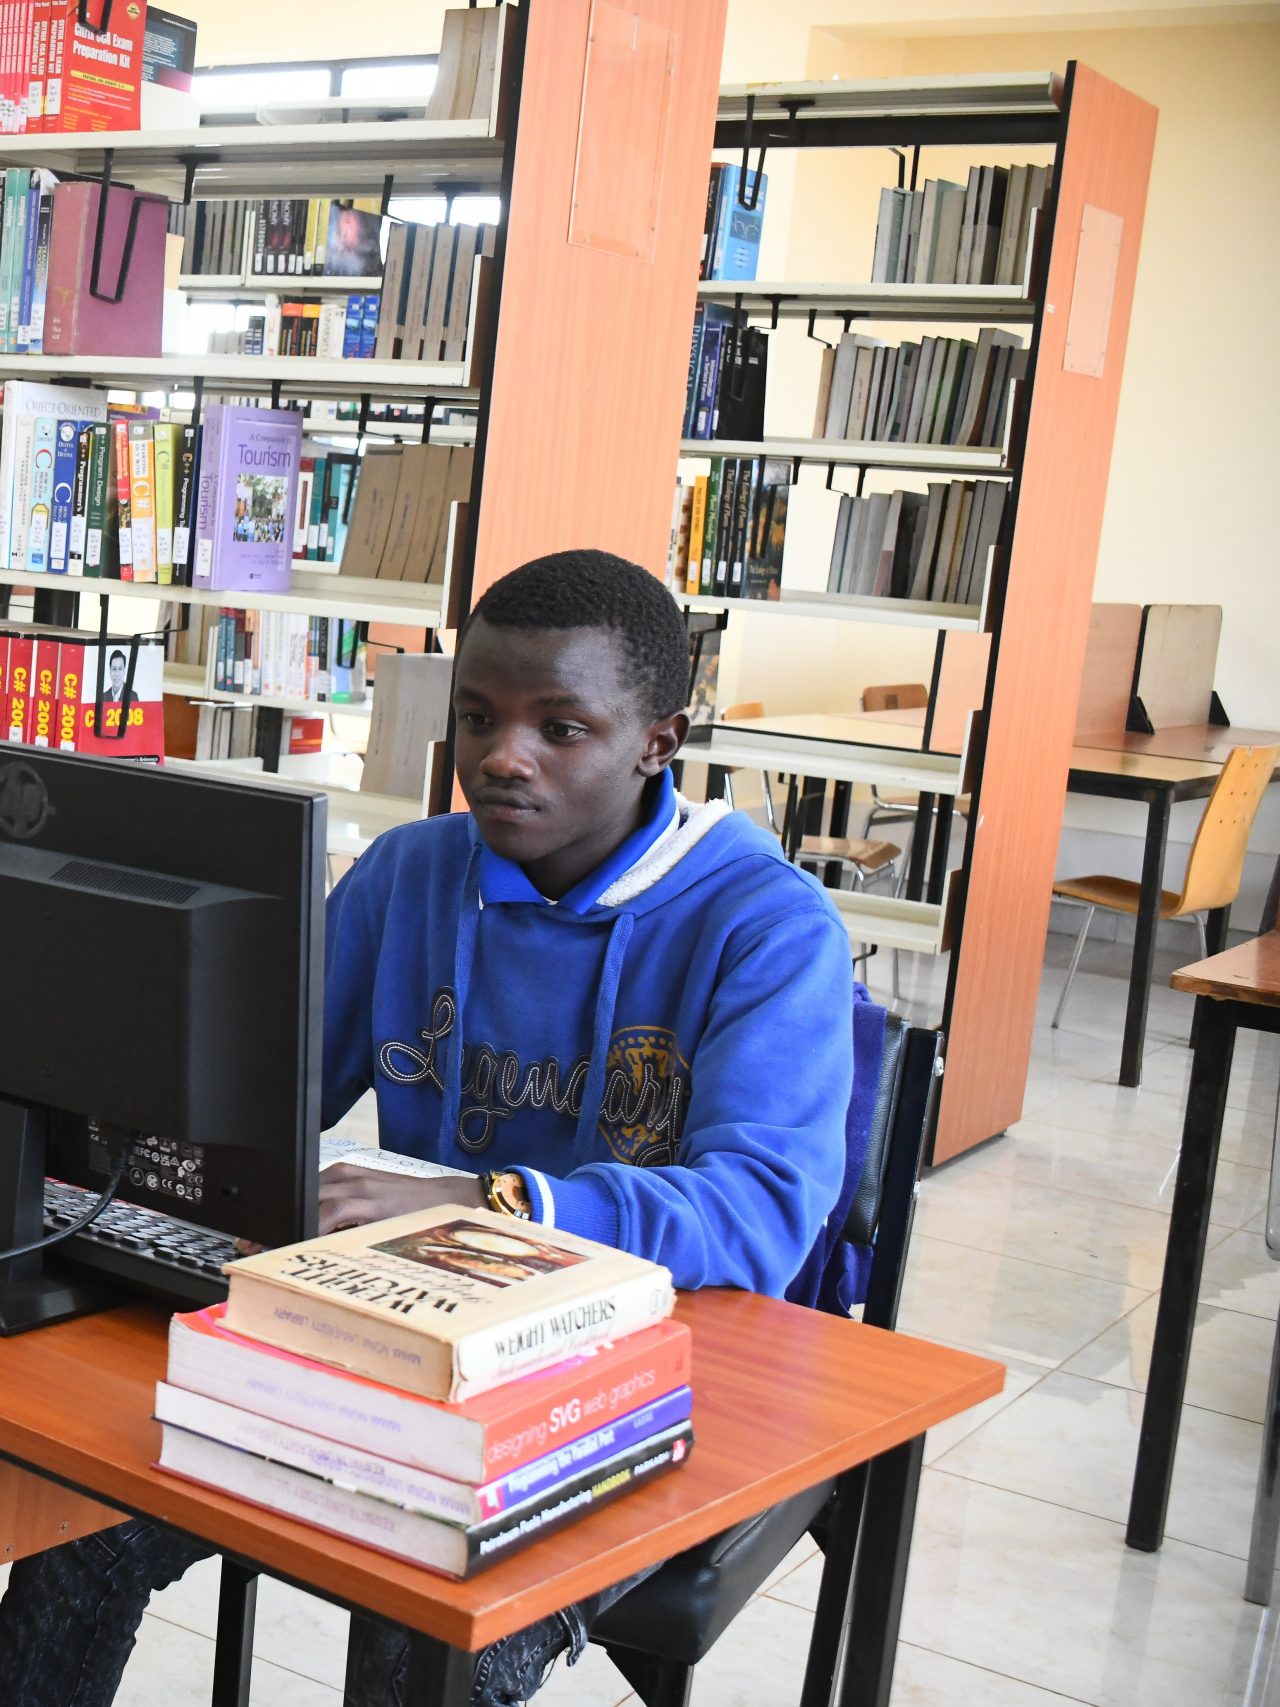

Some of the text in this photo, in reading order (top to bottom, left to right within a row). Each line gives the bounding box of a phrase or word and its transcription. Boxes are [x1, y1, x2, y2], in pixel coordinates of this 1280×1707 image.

[73, 40, 118, 66] Preparation
[258, 219, 266, 254] ASTRONOM
[94, 446, 106, 506] Program Design
[238, 444, 291, 468] Tourism
[198, 473, 213, 530] Tourism
[11, 667, 27, 728] C# 200
[36, 670, 53, 737] C# 200
[60, 673, 78, 742] C# 200
[494, 1295, 618, 1357] WEIGHT WATCHERS
[487, 1368, 657, 1465] designing SVG web graphics
